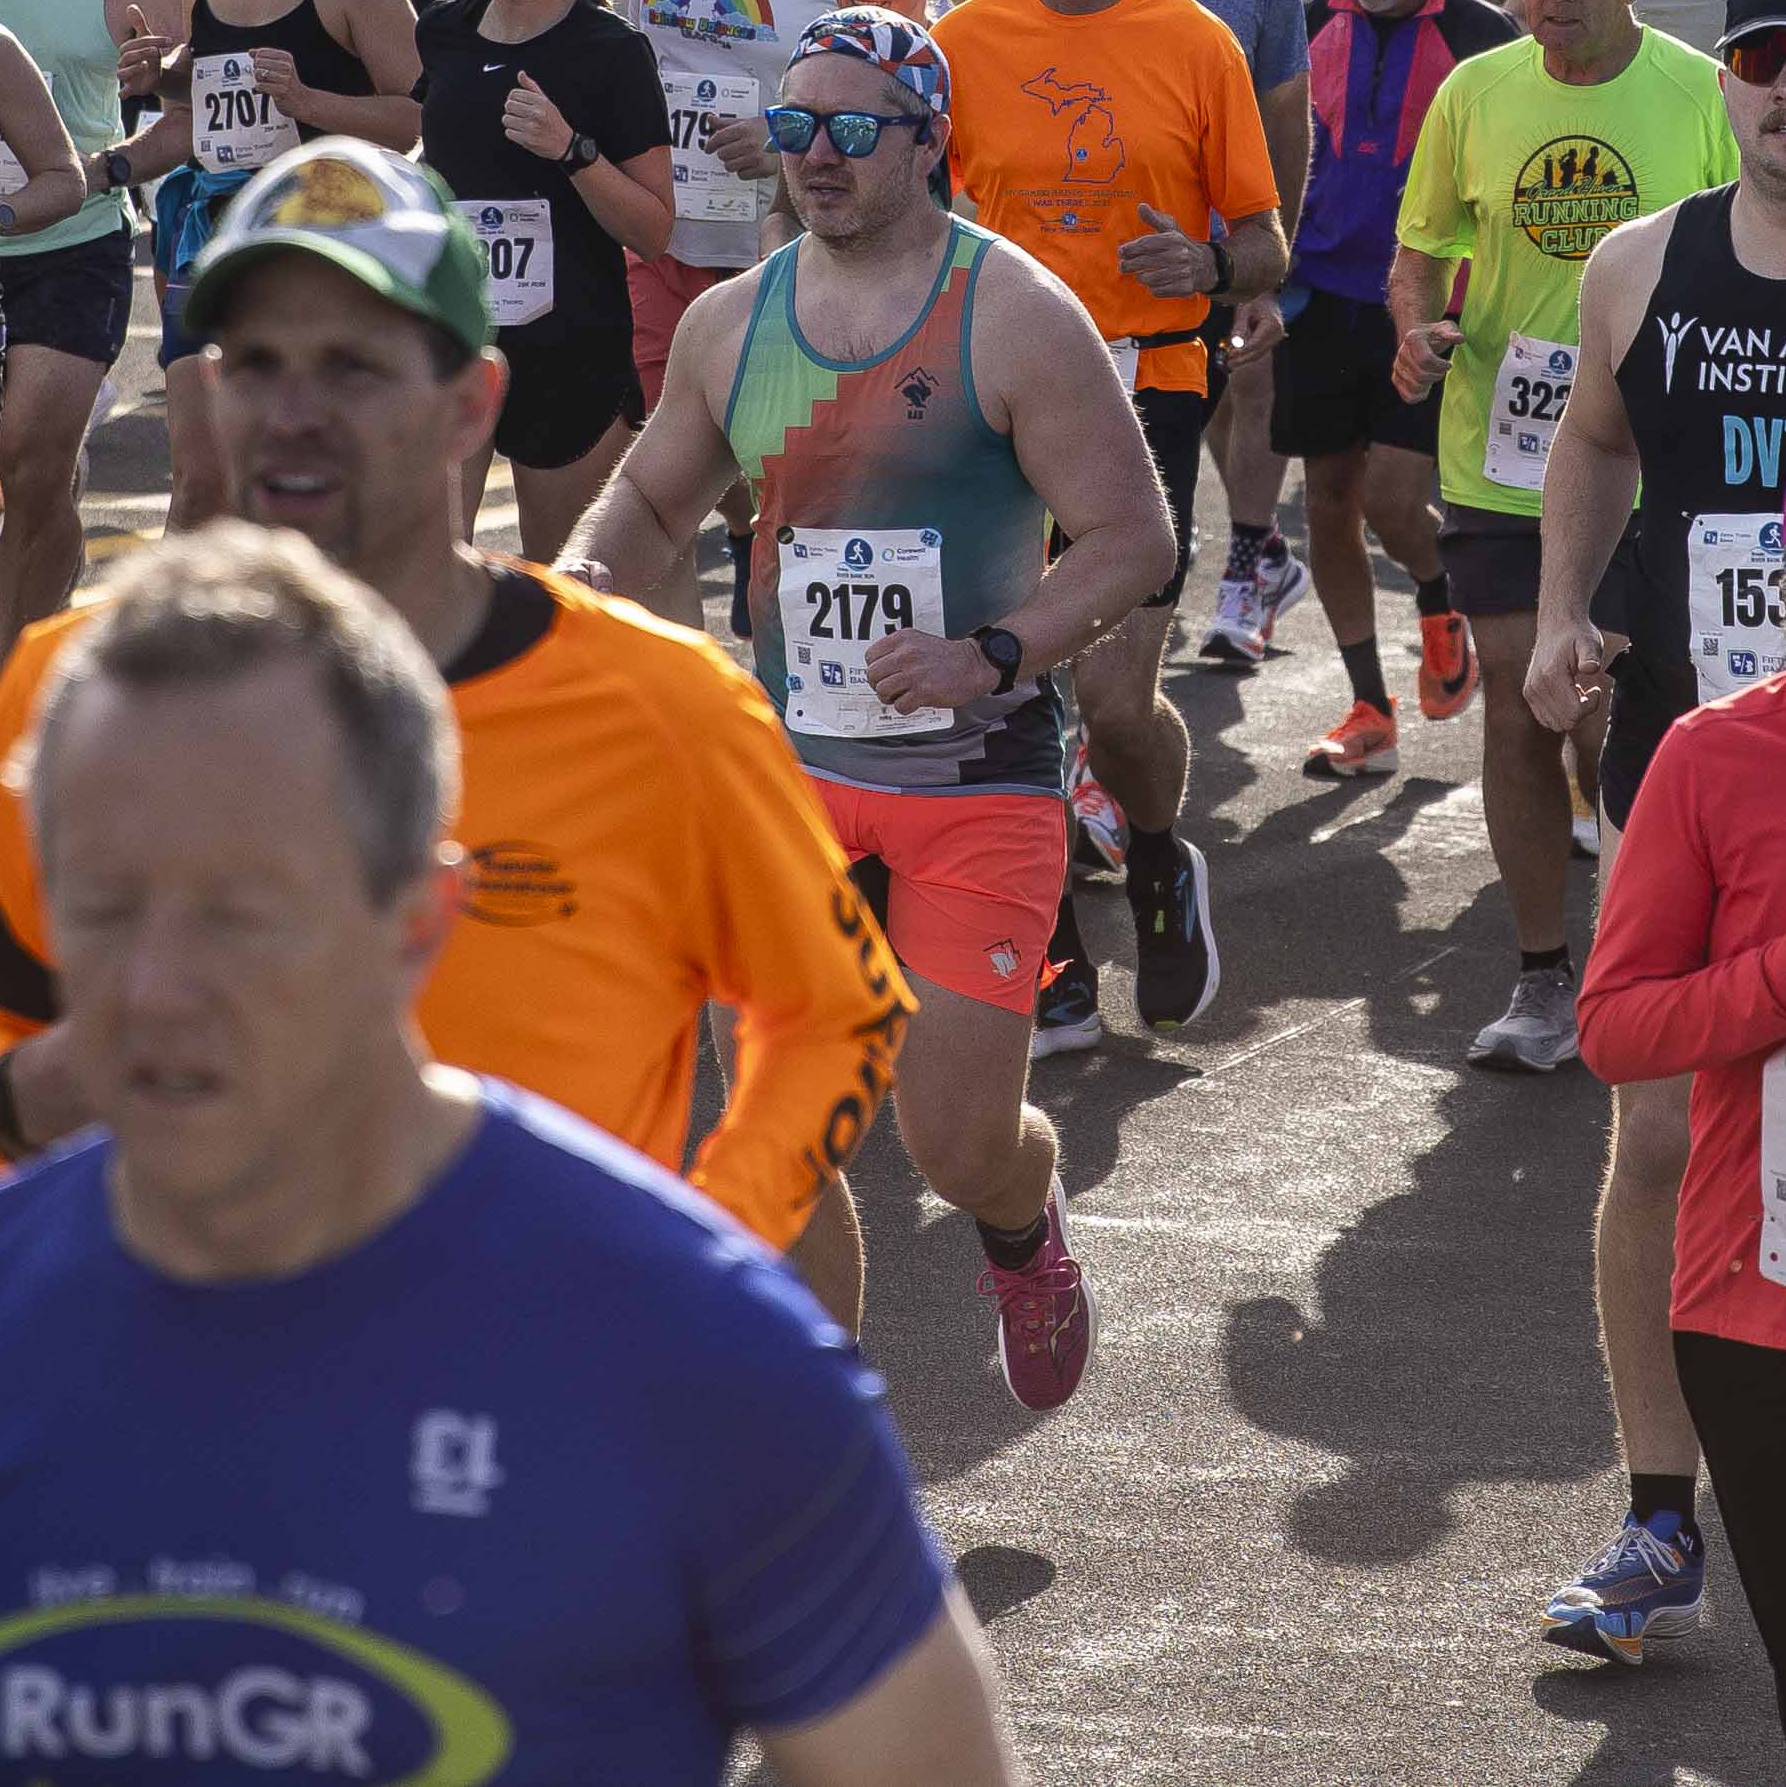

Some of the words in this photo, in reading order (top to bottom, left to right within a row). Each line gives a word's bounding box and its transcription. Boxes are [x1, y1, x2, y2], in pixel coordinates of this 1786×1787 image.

[205, 89, 271, 132] 2707
[670, 109, 737, 151] 179
[1513, 196, 1639, 226] RUNNING
[1700, 326, 1771, 357] VAN
[806, 581, 913, 641] 2179
